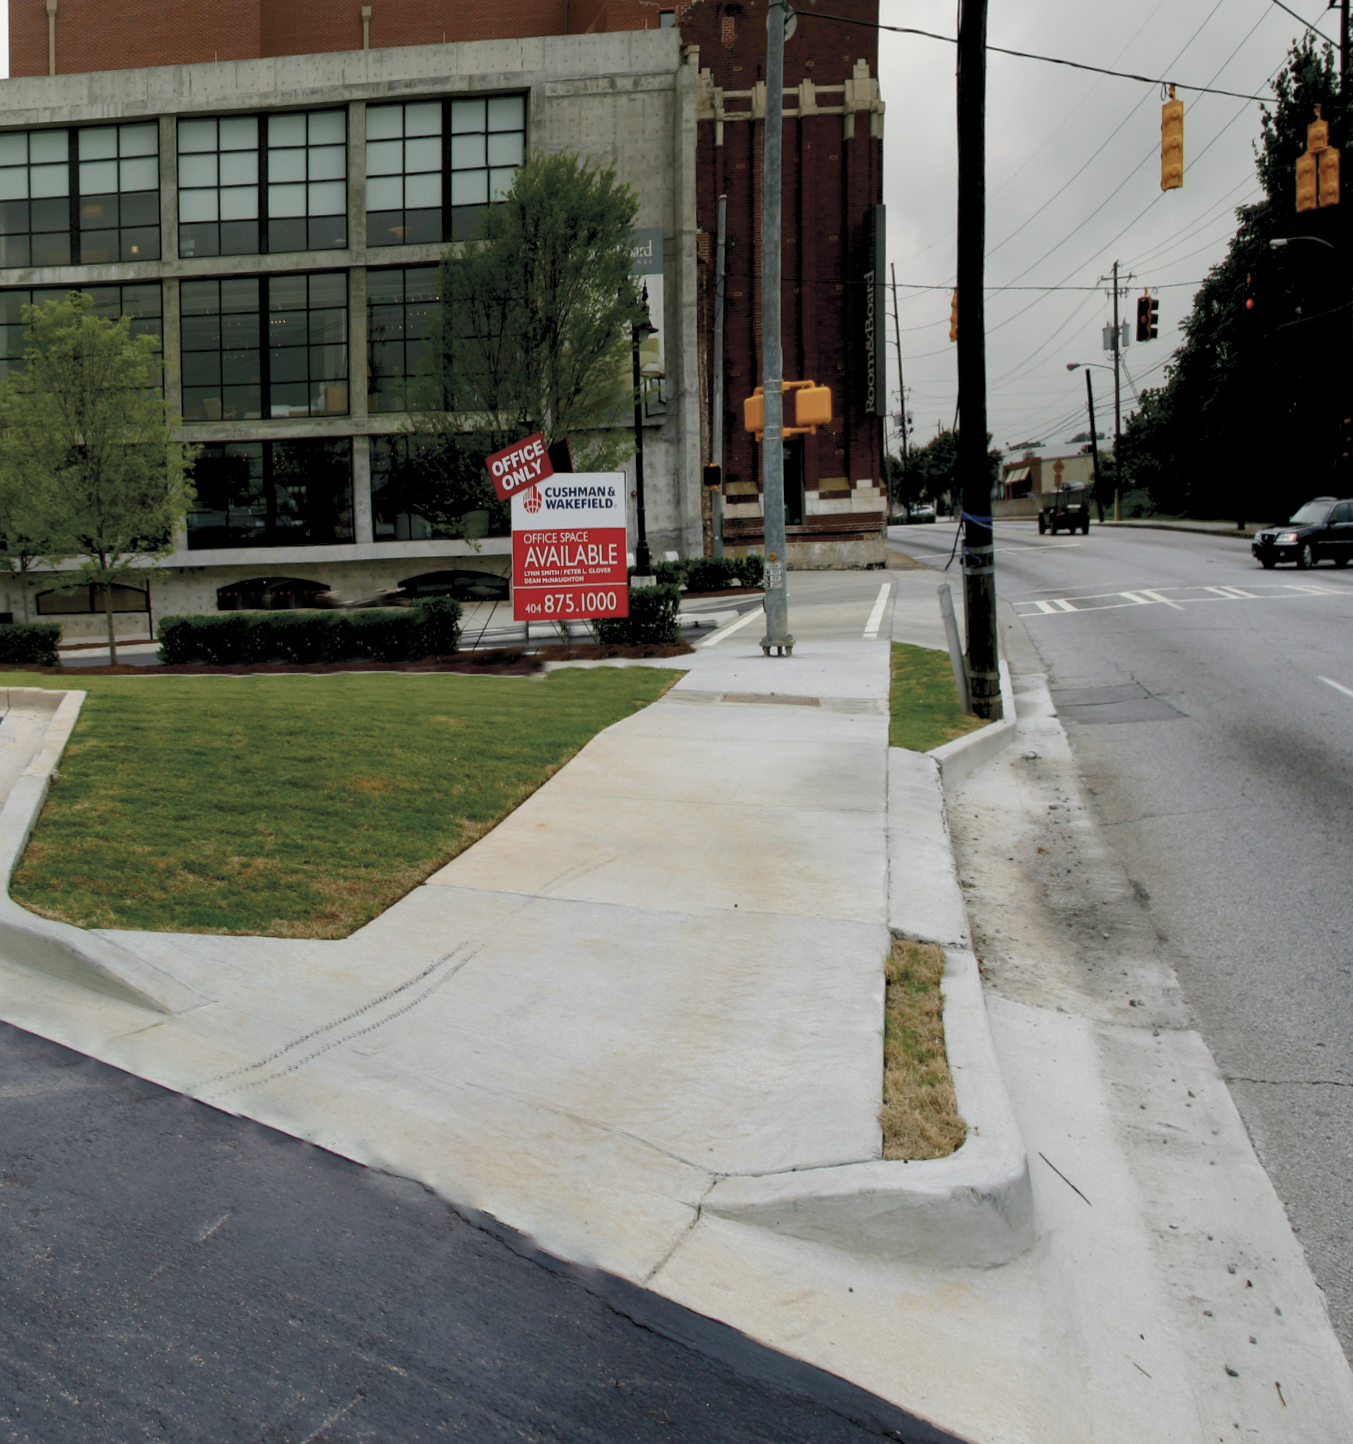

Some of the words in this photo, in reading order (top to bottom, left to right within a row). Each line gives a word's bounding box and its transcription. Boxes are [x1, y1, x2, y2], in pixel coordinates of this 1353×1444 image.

[863, 269, 875, 414] Room&Board
[492, 439, 545, 477] OFFICE
[502, 458, 542, 491] ONLY
[544, 486, 606, 498] CUSHMAN
[607, 486, 616, 497] &
[545, 498, 614, 510] WAKEFIELD
[523, 533, 558, 544] OFFICE
[559, 531, 589, 543] SPACE
[524, 543, 618, 568] AVAILABLE
[525, 603, 542, 614] 404
[544, 591, 618, 613] 875.1000
